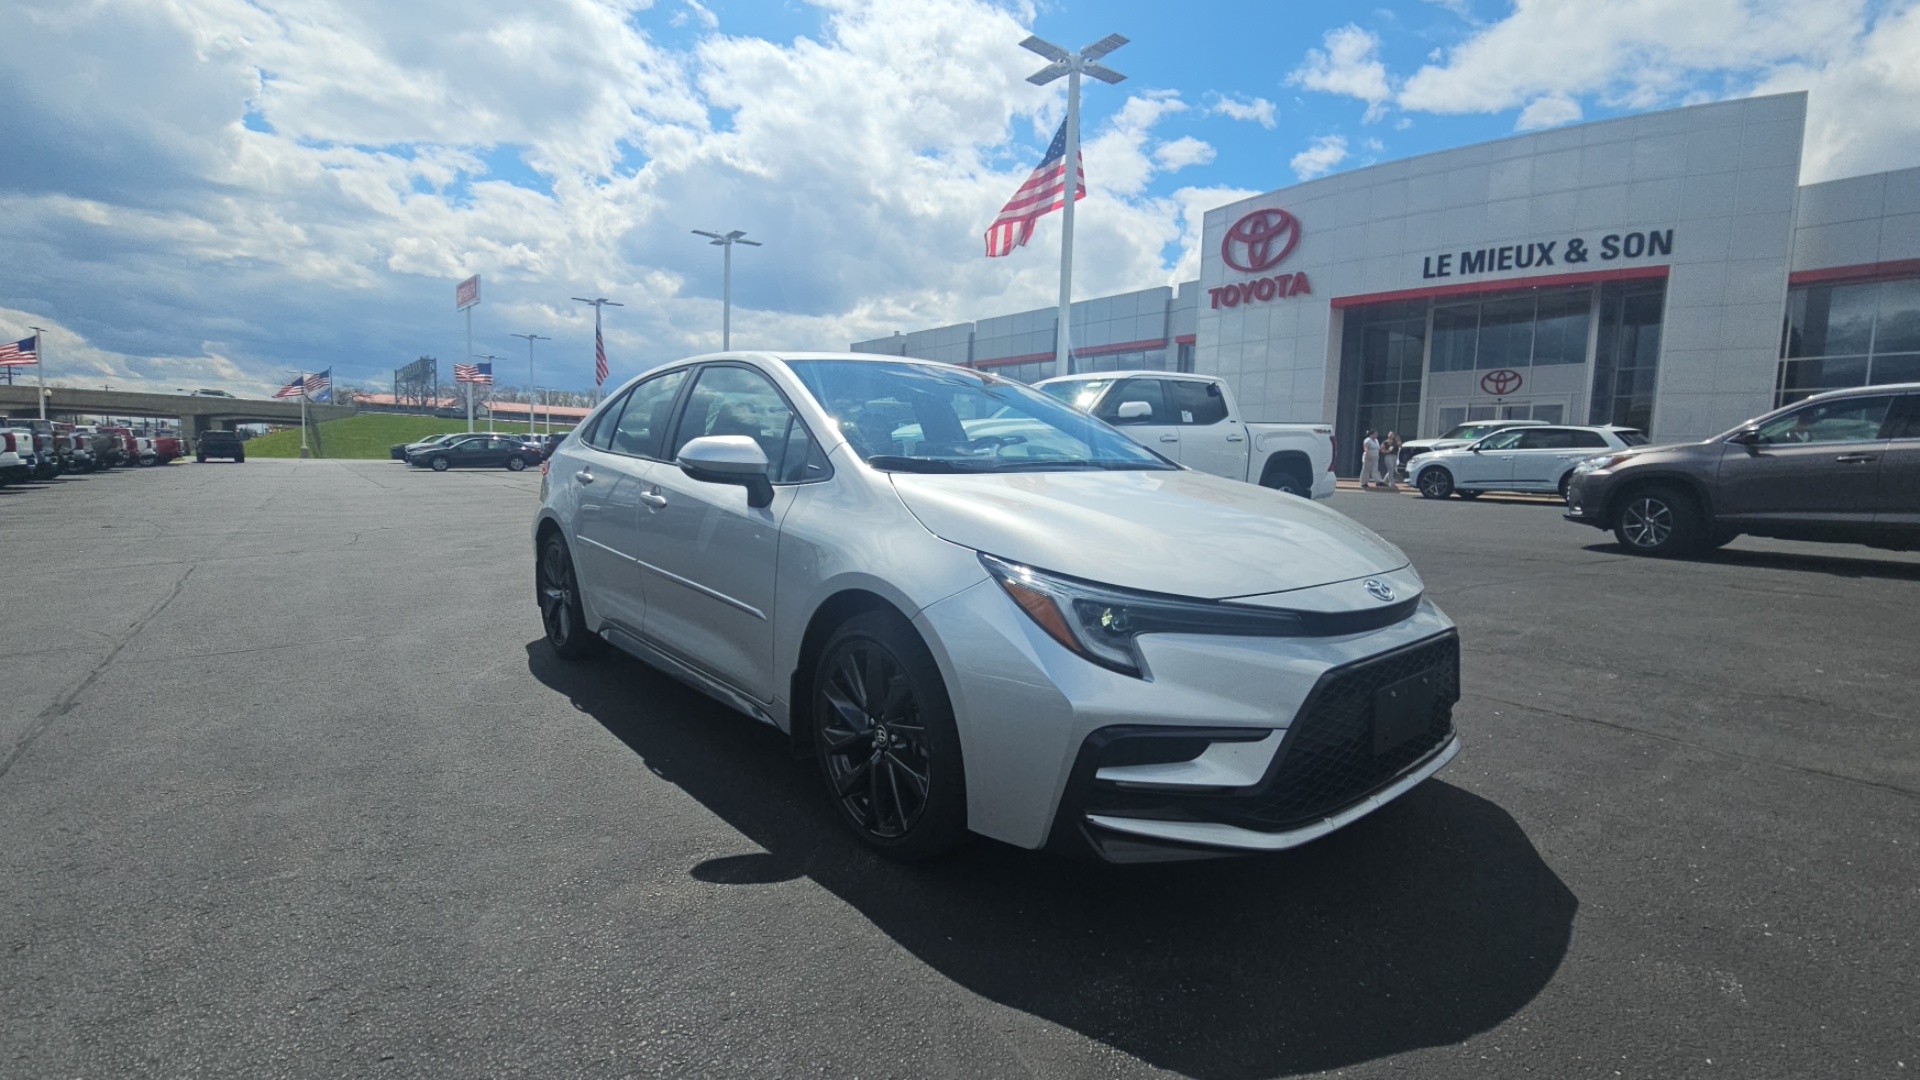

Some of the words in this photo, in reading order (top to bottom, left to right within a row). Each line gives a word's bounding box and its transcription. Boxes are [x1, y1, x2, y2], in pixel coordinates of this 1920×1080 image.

[1423, 254, 1452, 279] LE
[1460, 242, 1556, 275] MIEUX
[1564, 238, 1588, 263] &
[1600, 229, 1673, 260] SON
[1208, 271, 1311, 309] TOYOTA
